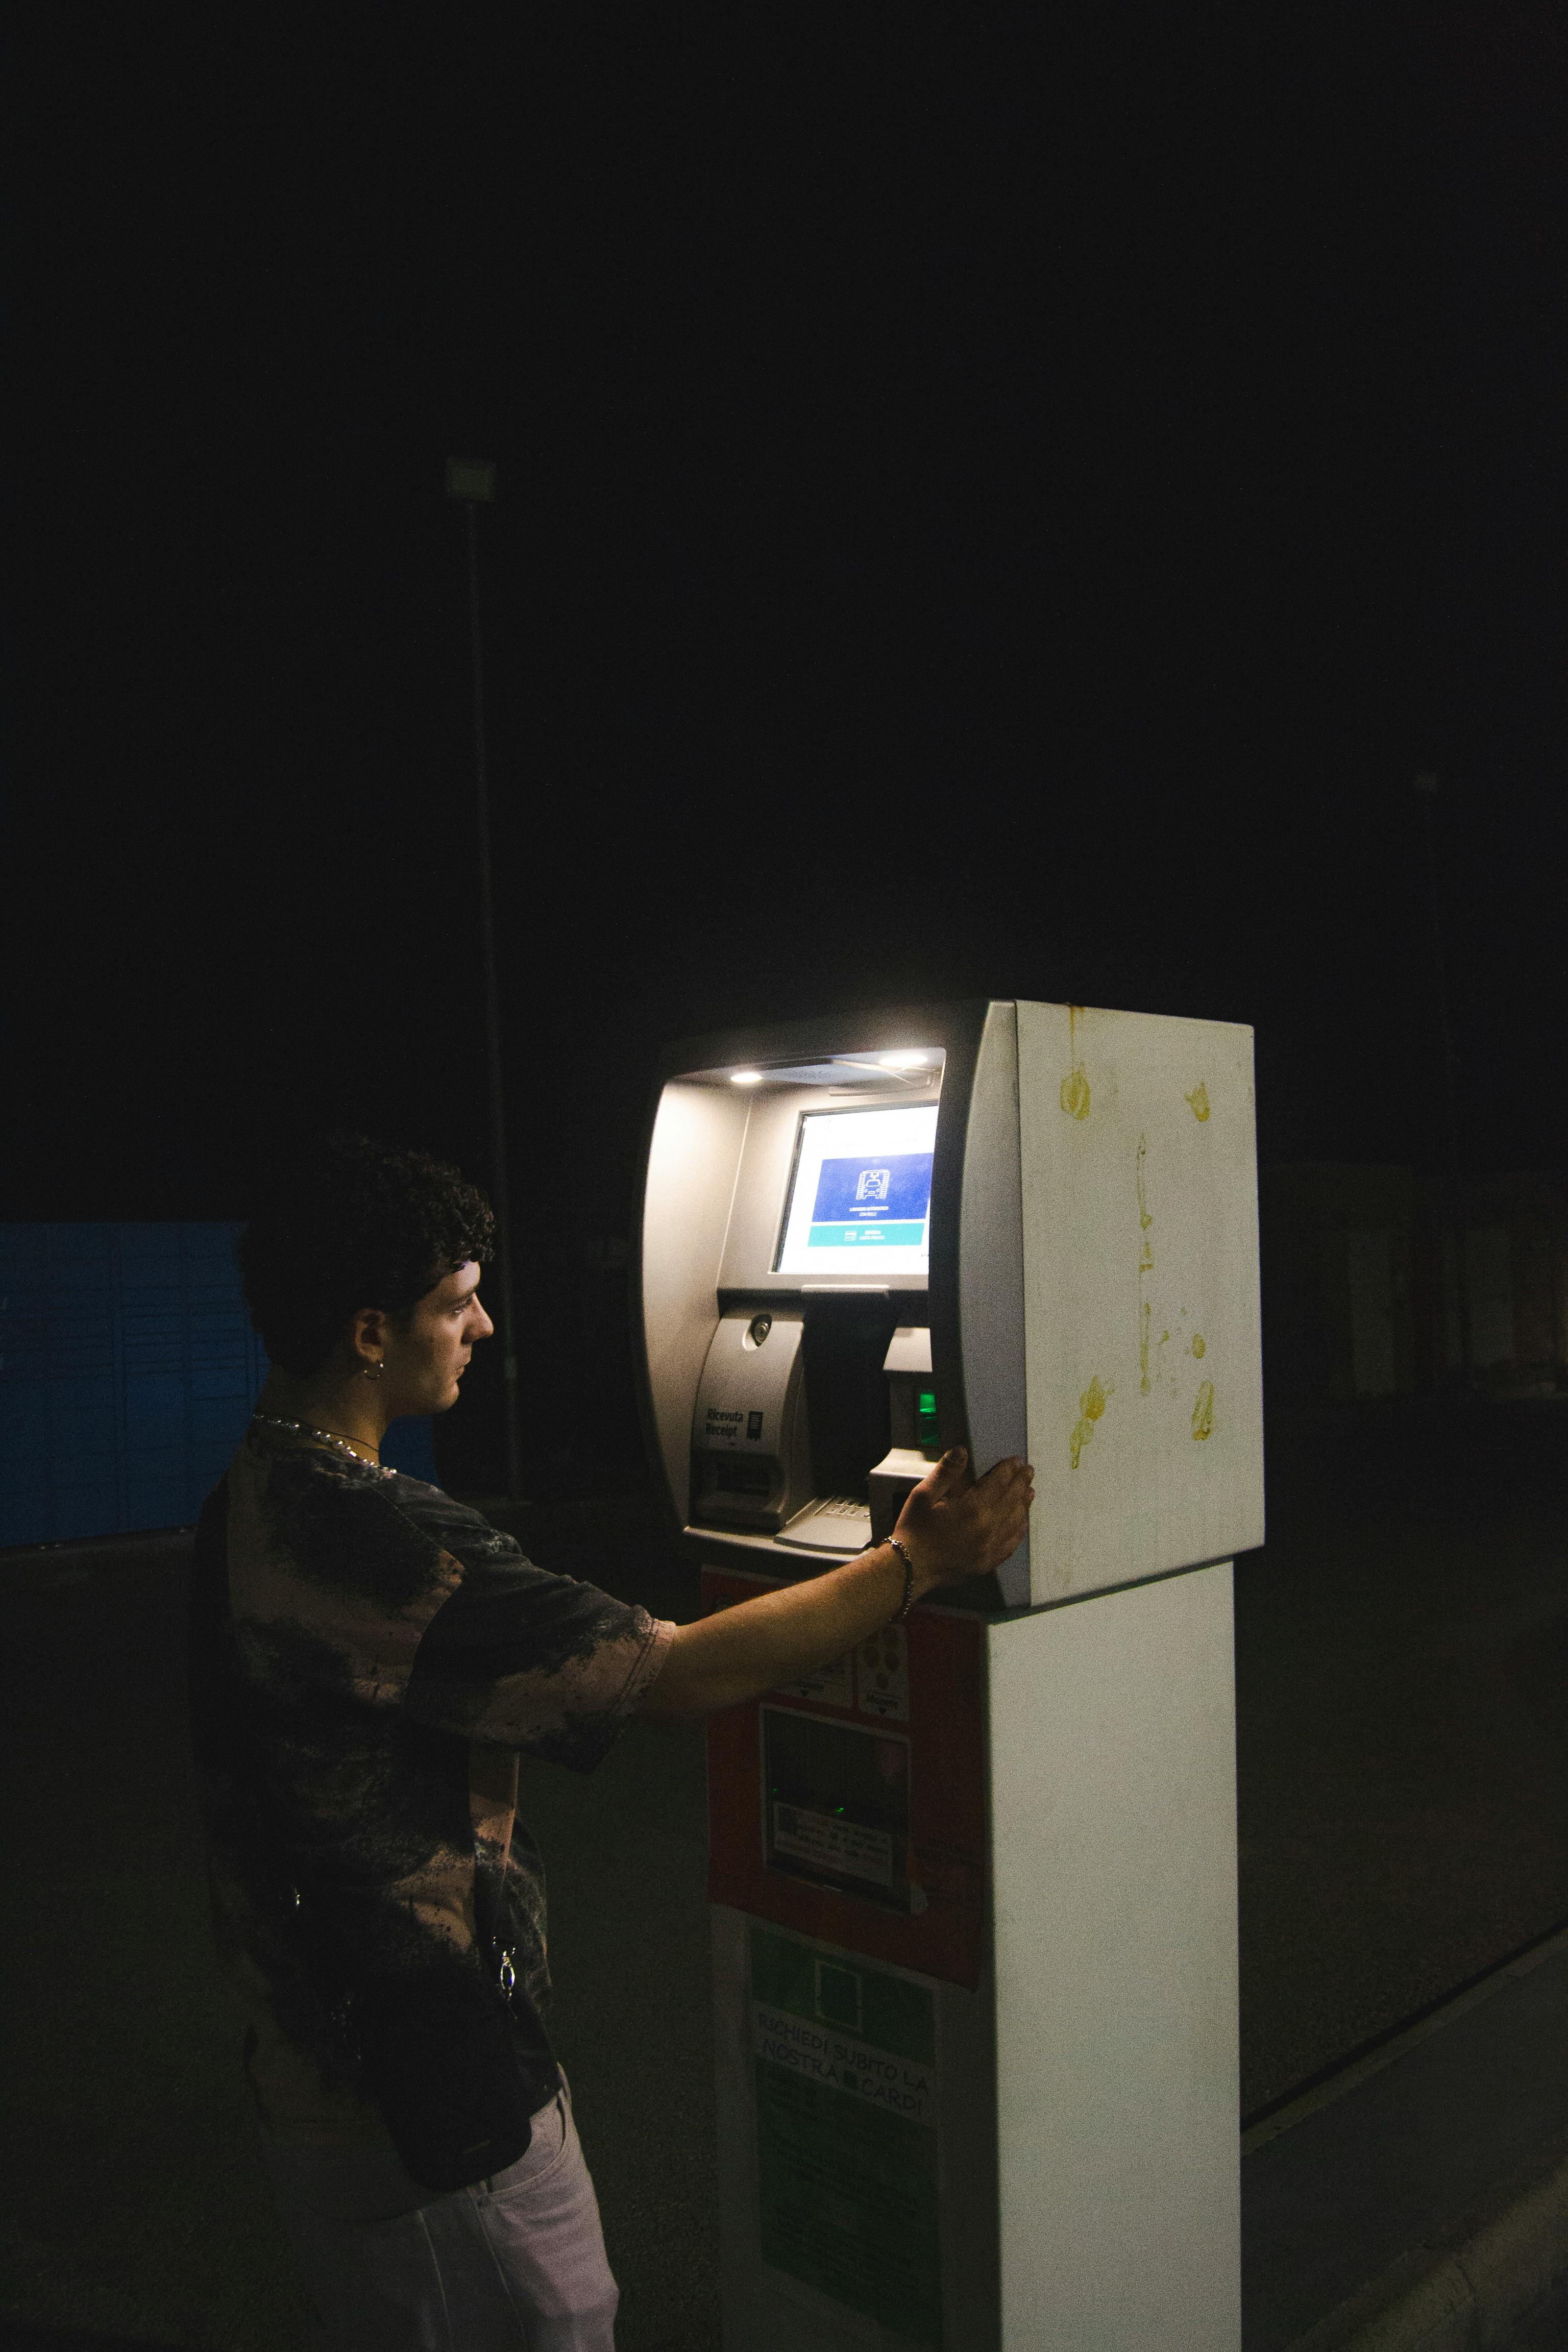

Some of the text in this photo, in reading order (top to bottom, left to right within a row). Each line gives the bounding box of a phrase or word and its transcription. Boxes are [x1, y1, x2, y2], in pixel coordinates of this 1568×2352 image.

[707, 1408, 743, 1422] Ricevuta
[705, 1423, 737, 1438] Receipt
[758, 2013, 929, 2095] RICHIEDI SUBITO LA
[763, 2038, 839, 2082] NOSTRA
